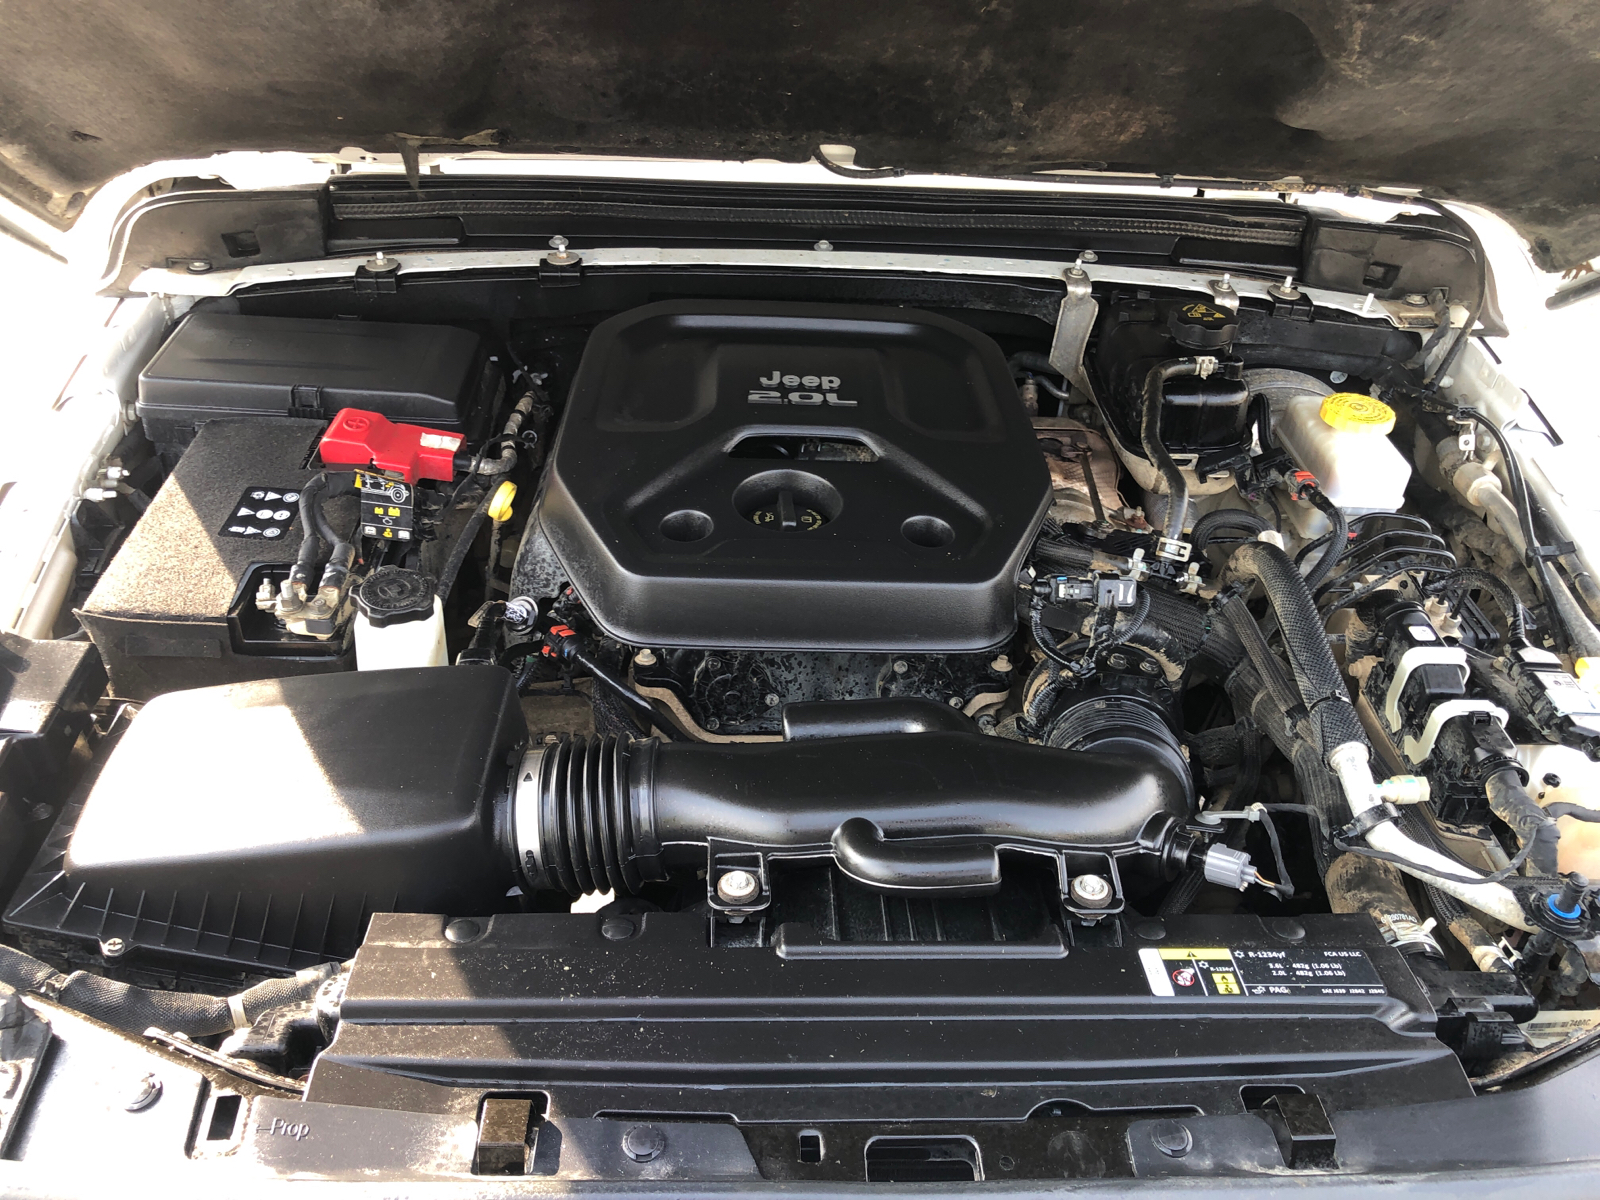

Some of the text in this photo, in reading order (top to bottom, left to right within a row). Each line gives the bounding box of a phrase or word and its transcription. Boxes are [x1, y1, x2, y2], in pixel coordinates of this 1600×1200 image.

[760, 371, 841, 391] Jeep
[748, 390, 858, 406] 2.0L
[1248, 951, 1286, 959] R-1234yf
[1269, 986, 1287, 994] PAG
[270, 1117, 310, 1141] Prop
